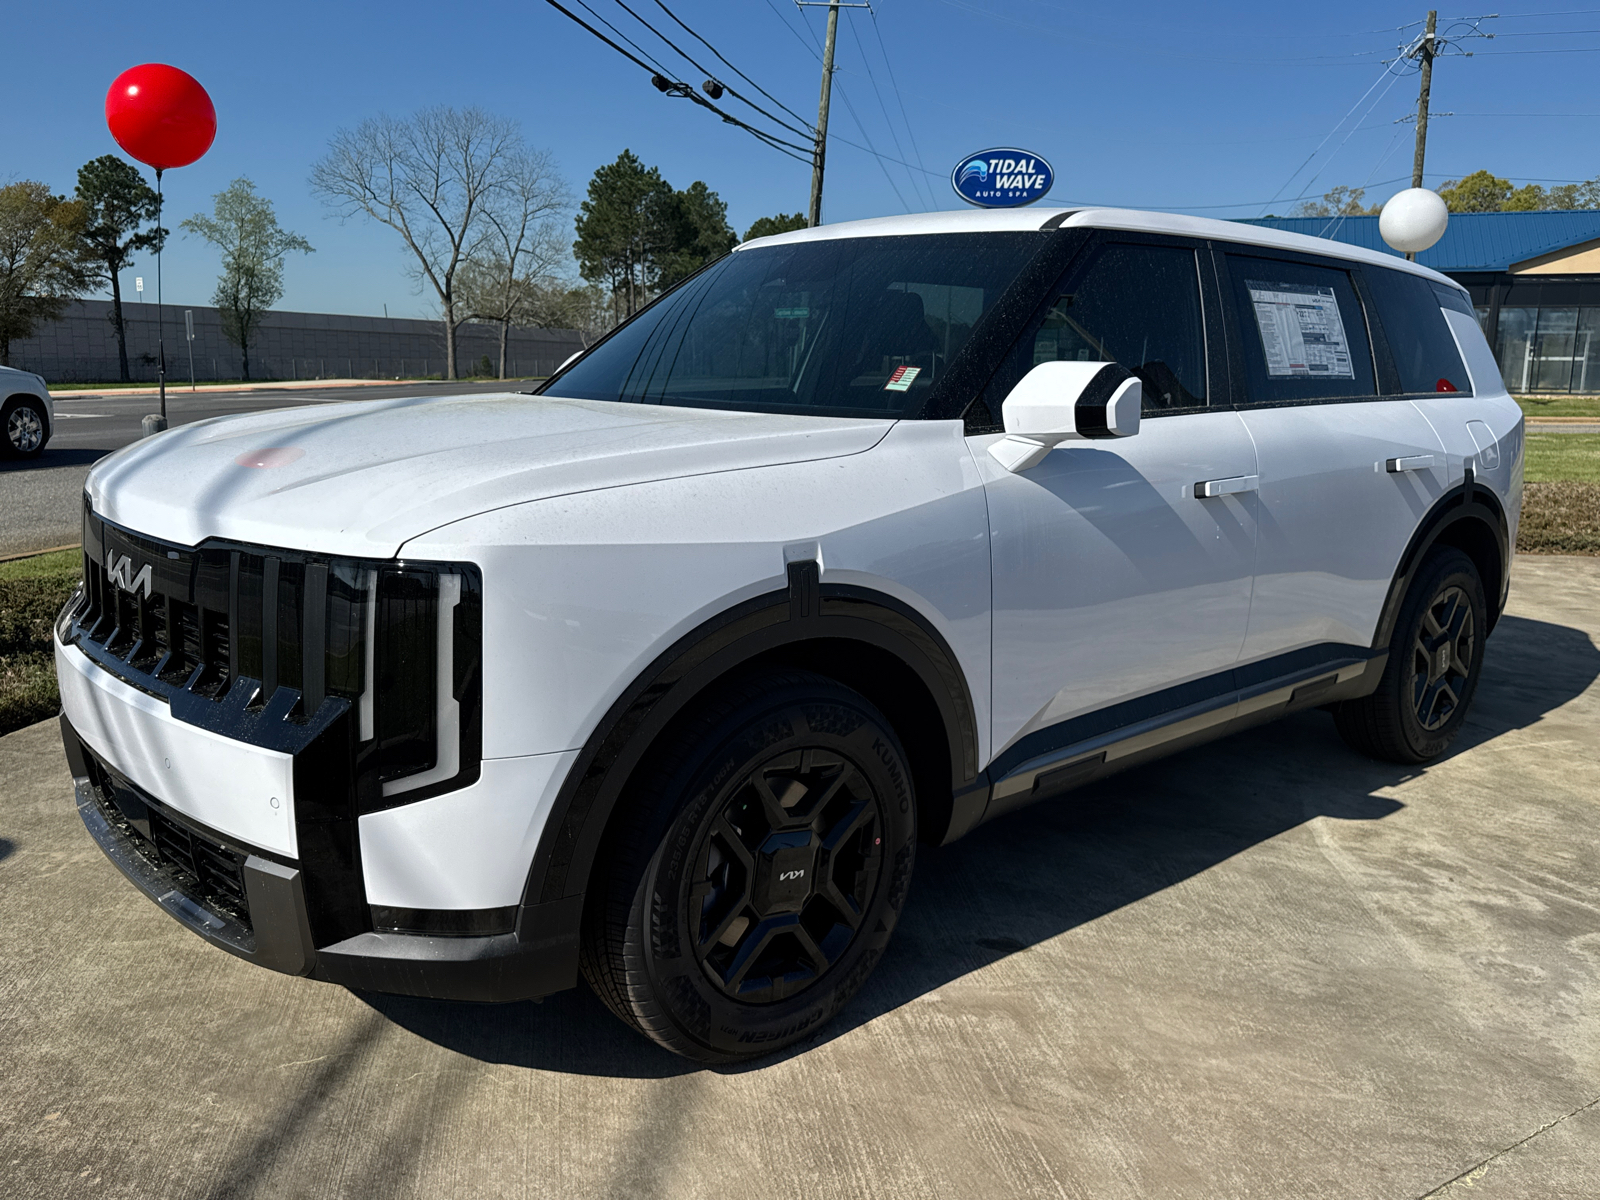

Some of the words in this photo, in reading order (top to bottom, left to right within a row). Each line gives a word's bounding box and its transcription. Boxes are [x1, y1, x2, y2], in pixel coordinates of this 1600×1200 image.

[988, 159, 1036, 173] TIDAL
[995, 174, 1046, 189] WAVE
[107, 549, 152, 600] KIA
[871, 737, 909, 814] KUMHO
[668, 827, 691, 881] 235/65
[687, 794, 708, 825] R18
[707, 758, 735, 791] 106H
[779, 869, 804, 881] KIA
[720, 1024, 739, 1036] HP71
[738, 1008, 824, 1043] CRUGEN
